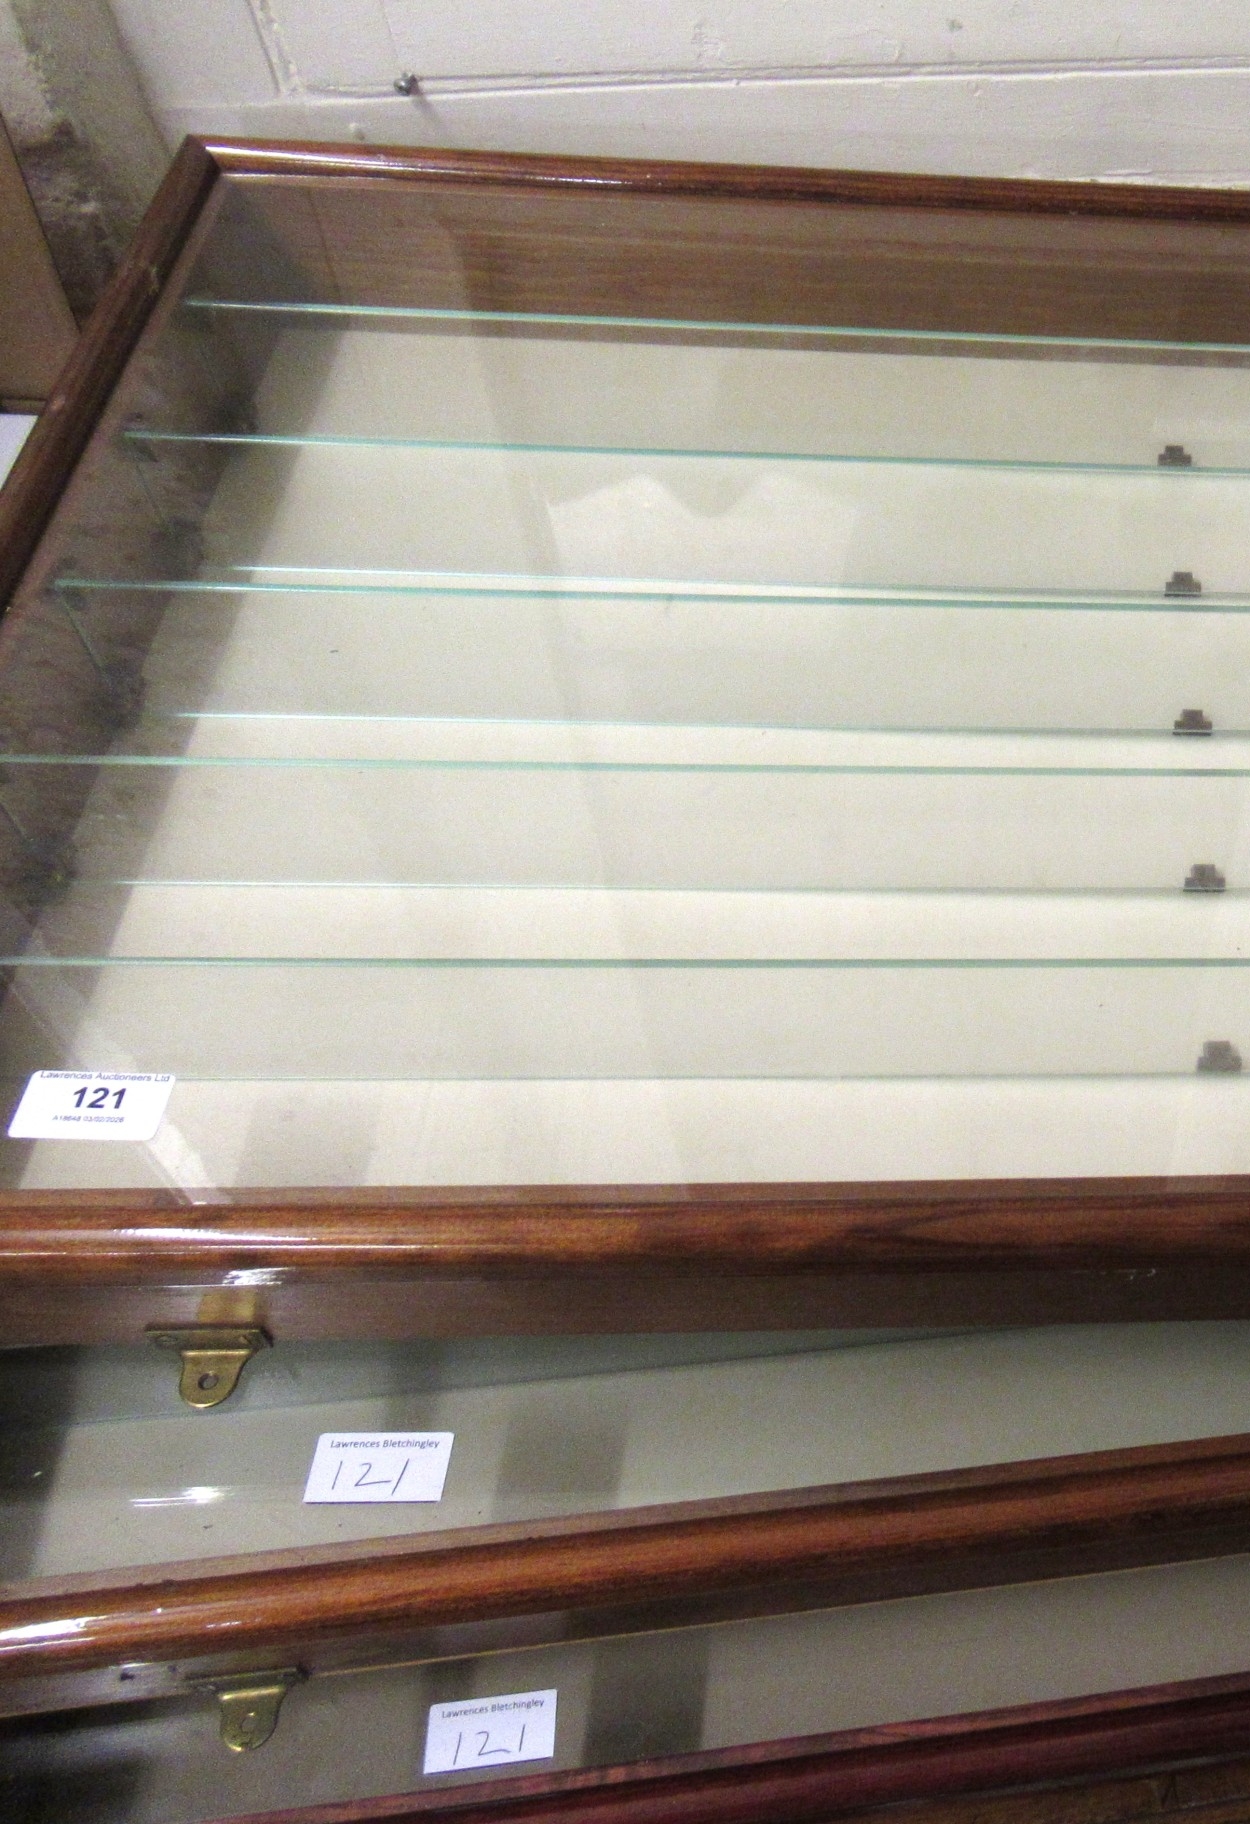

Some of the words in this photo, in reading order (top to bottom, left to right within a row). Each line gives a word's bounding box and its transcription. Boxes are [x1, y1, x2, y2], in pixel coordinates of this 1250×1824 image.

[40, 1070, 93, 1080] Lawrences
[95, 1072, 152, 1082] Auctioneers
[154, 1074, 170, 1083] Ltd
[73, 1086, 127, 1109] 121
[330, 1440, 380, 1448] Lawrences
[382, 1439, 440, 1449] Bletchingley
[331, 1458, 410, 1496] 121
[441, 1706, 489, 1719] Lawrences
[490, 1698, 545, 1712] Bletchingley
[452, 1723, 526, 1766] 121
